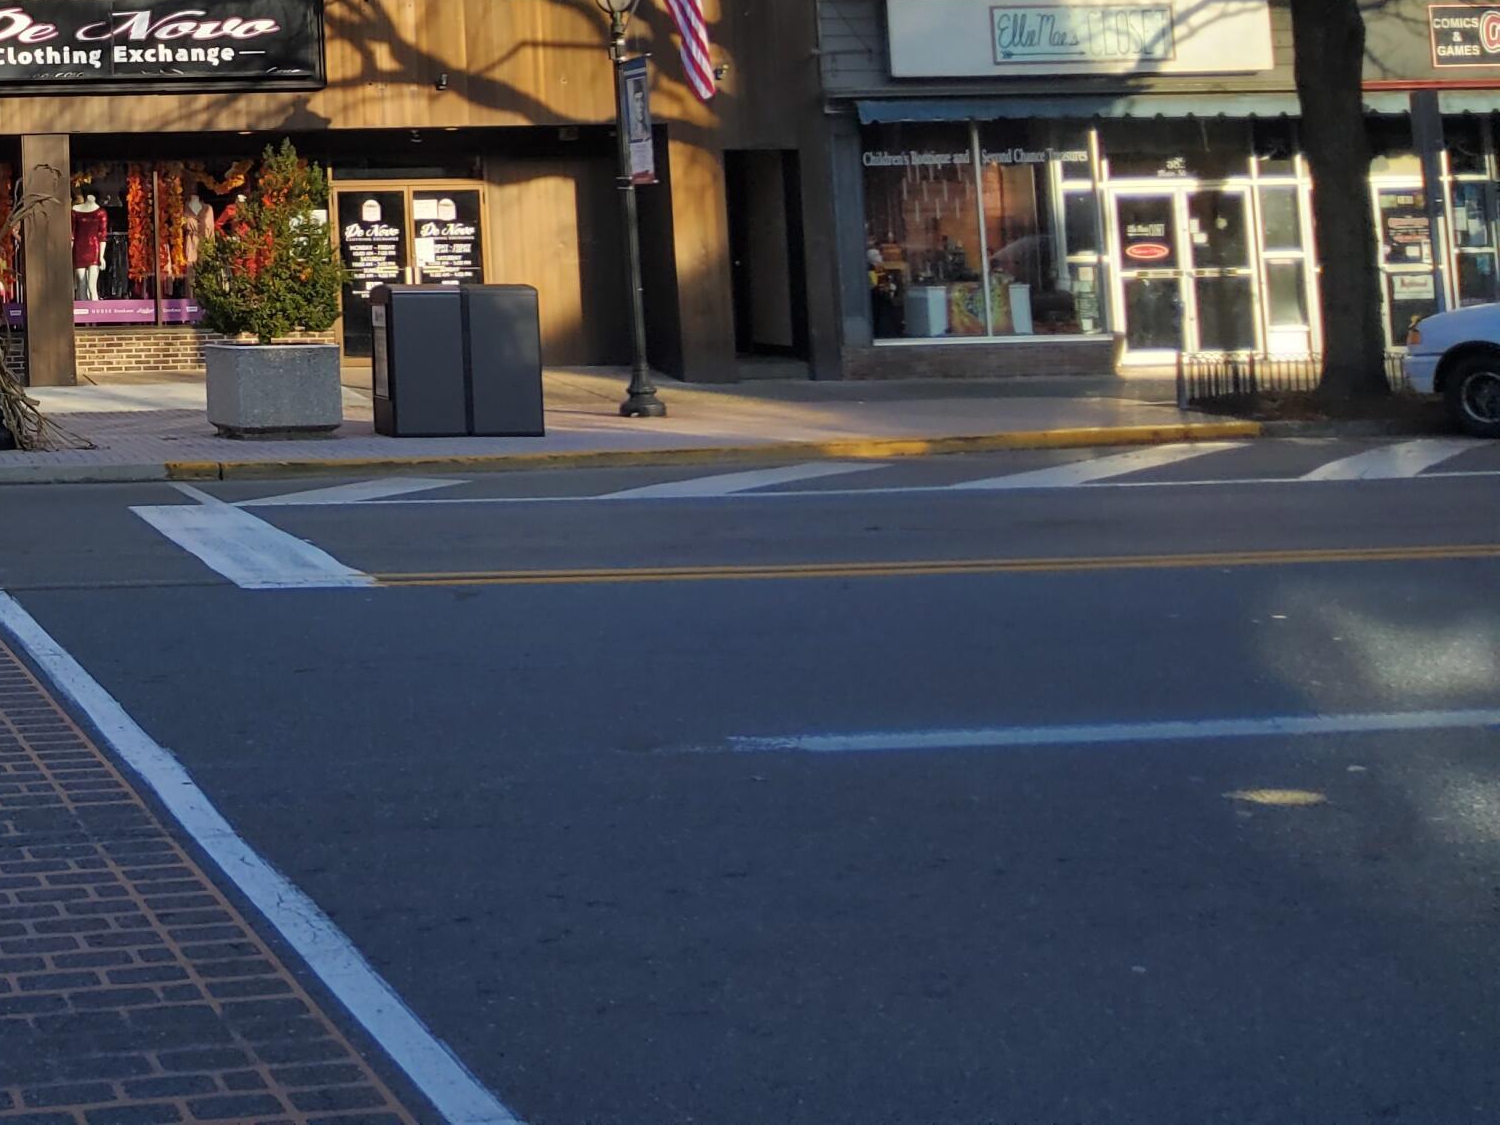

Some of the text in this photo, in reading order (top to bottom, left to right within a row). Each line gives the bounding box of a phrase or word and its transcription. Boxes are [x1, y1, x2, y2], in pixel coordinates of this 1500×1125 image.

[76, 9, 281, 42] Novo
[1433, 17, 1479, 29] COMICS
[1087, 9, 1168, 56] CLOSET
[1452, 31, 1463, 42] &
[113, 44, 236, 66] Exchange
[1437, 45, 1480, 56] GAMES
[952, 149, 970, 164] and
[982, 149, 1013, 164] Second
[1013, 148, 1045, 163] Chance
